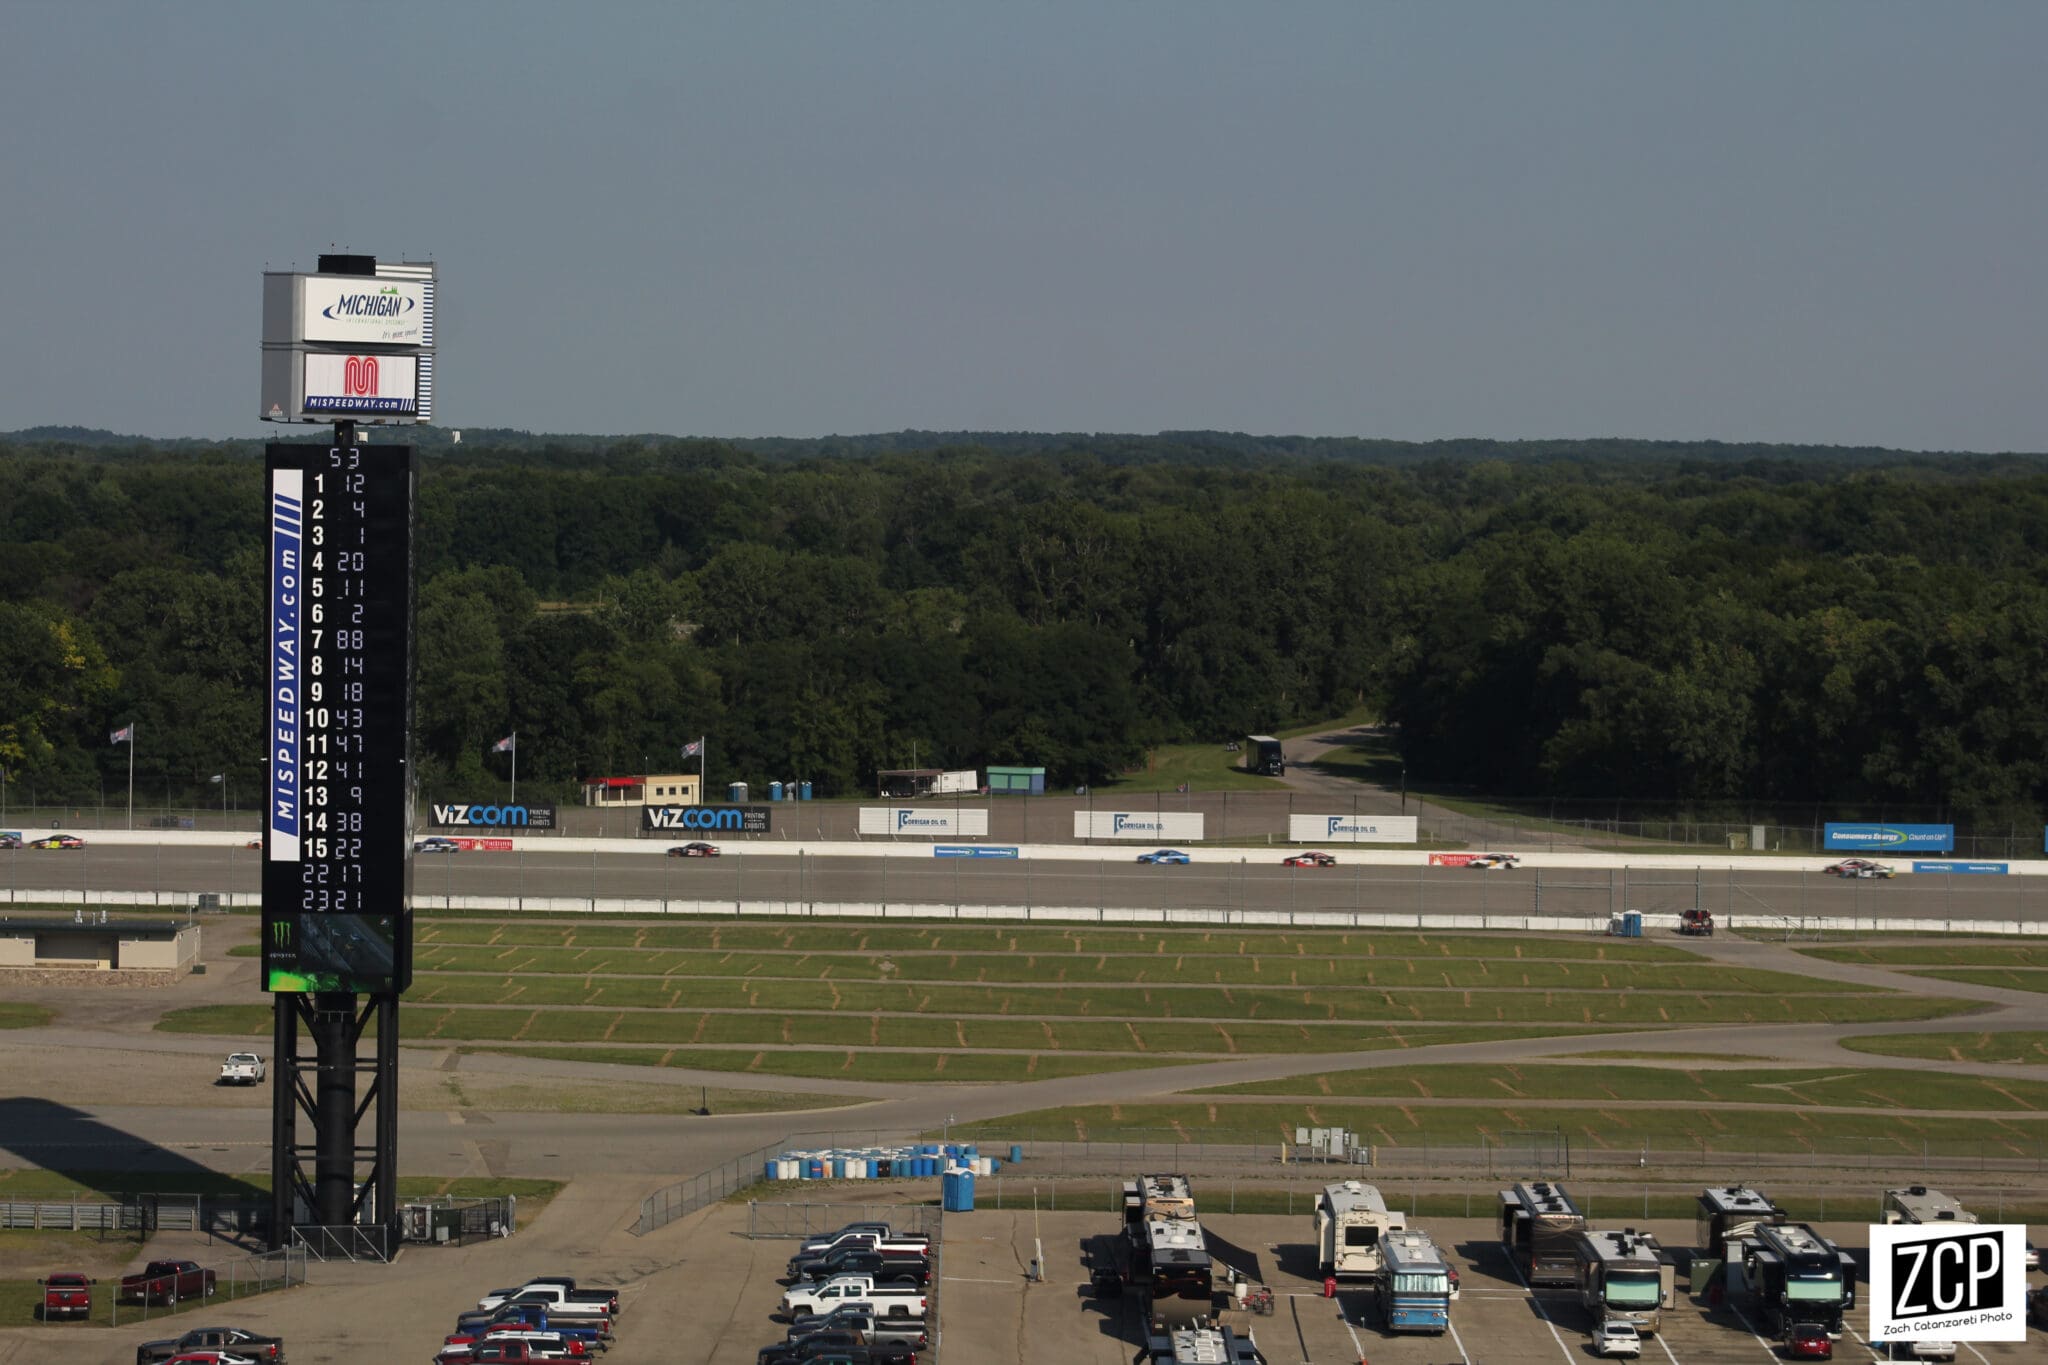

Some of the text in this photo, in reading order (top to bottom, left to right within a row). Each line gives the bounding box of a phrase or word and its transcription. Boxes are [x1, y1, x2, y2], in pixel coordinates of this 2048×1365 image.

[336, 294, 402, 317] MICHIGAN
[310, 398, 398, 409] MISPEEDWAY.com
[315, 474, 365, 493] 1 12
[312, 500, 365, 519] 2 4
[312, 526, 365, 545] 3 1
[312, 552, 364, 571] 4 20
[312, 578, 364, 597] 5 11
[312, 604, 364, 623] 6 2
[311, 630, 363, 650] 7 88
[311, 656, 363, 675] 8 14
[278, 549, 296, 820] MISPEEDWAY.com
[311, 682, 363, 702] 9 18
[305, 708, 363, 728] 10 43
[306, 734, 363, 754] 11 47
[304, 760, 362, 780] 12 41
[304, 786, 362, 806] 13 9
[304, 812, 362, 832] 14 38
[304, 838, 362, 858] 15 22
[303, 864, 362, 883] 22 17
[303, 890, 362, 909] 23 21
